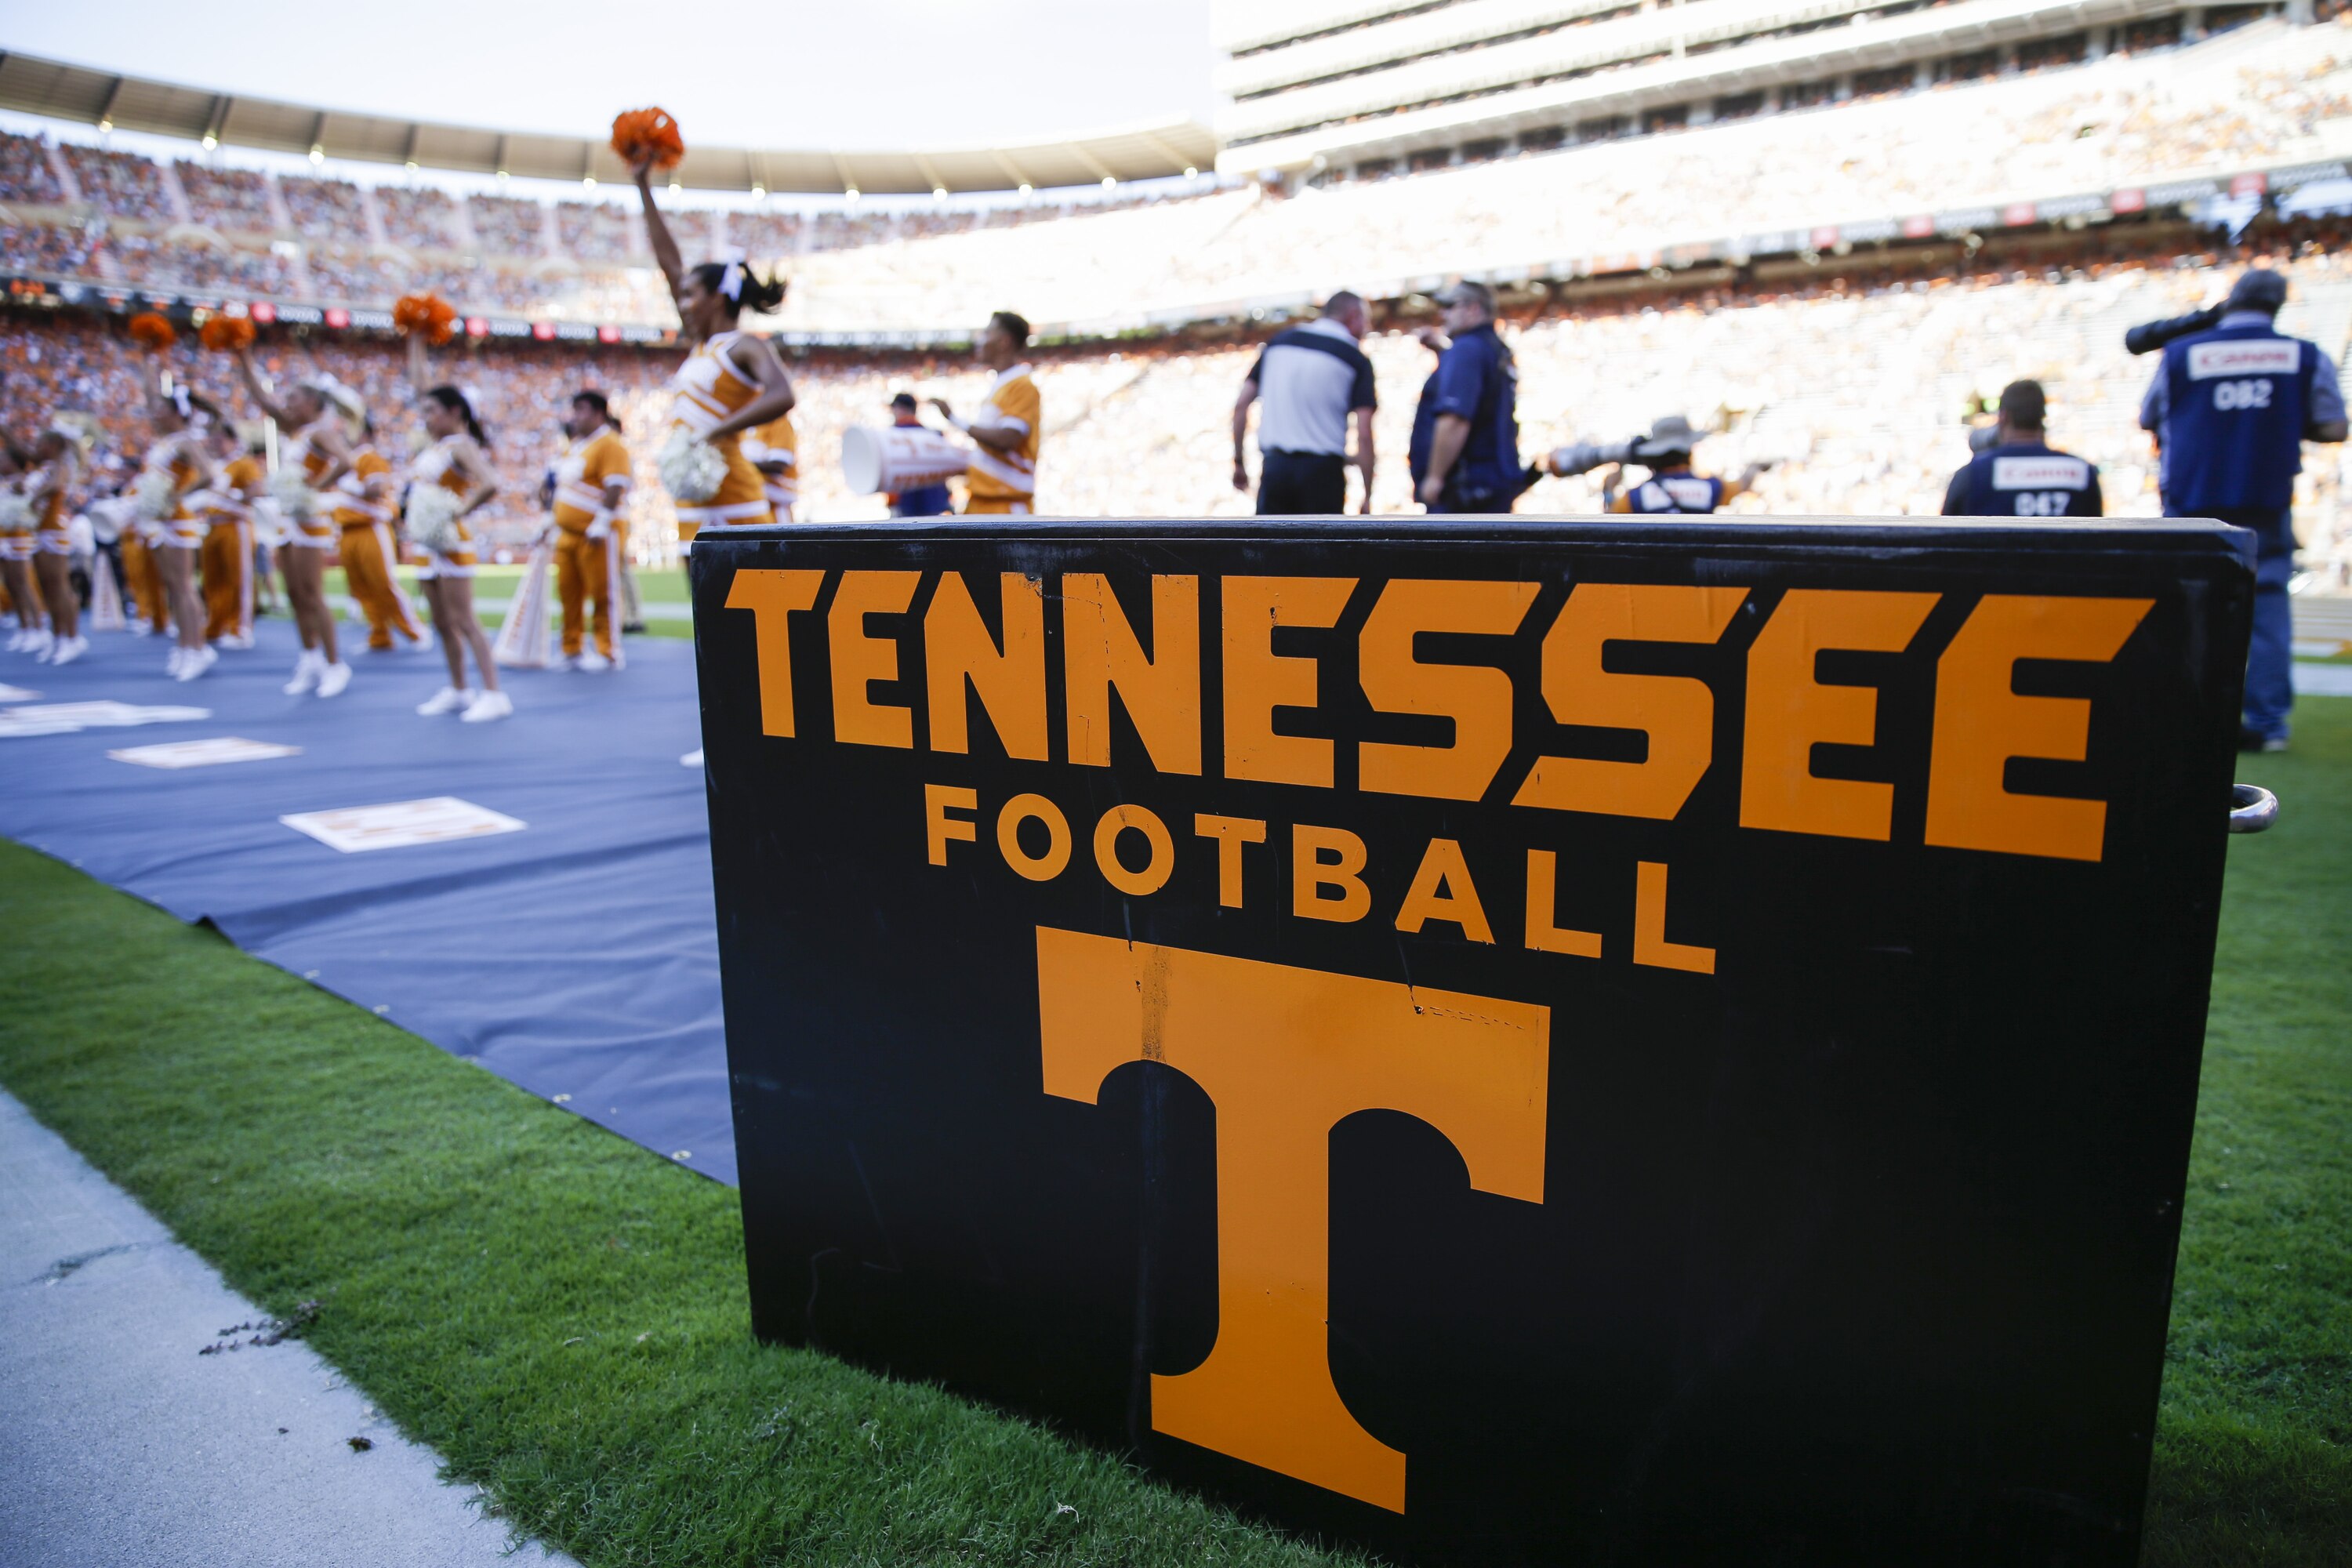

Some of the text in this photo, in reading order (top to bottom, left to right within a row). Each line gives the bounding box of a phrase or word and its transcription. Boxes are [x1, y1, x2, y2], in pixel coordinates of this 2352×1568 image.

[724, 568, 2155, 862] TENNESSEE
[924, 783, 1716, 975] FOOTBALL
[1036, 925, 1551, 1514] T
